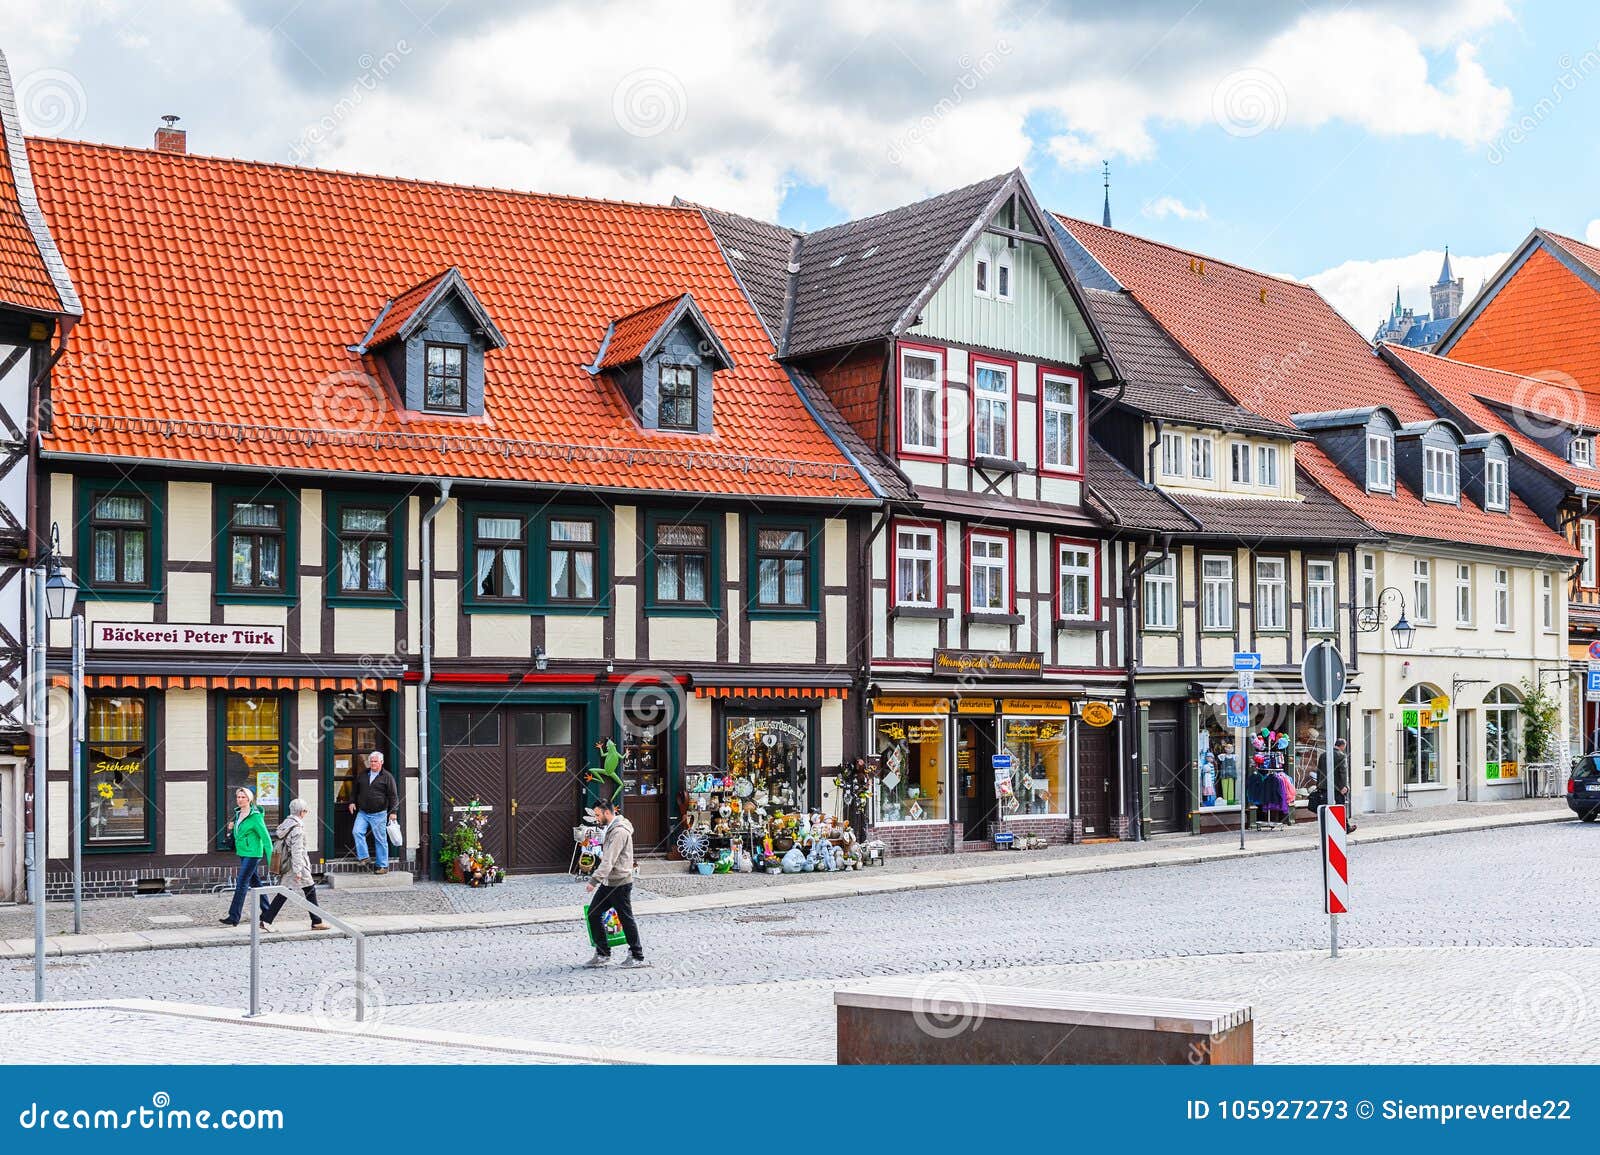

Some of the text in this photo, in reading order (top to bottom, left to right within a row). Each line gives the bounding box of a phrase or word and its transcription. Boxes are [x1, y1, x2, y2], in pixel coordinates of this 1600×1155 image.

[102, 627, 275, 645] Bäckerei Peter Türk
[990, 655, 1041, 671] Bimmelbahn
[1229, 716, 1247, 724] TAXI
[93, 761, 140, 774] Stehcafé
